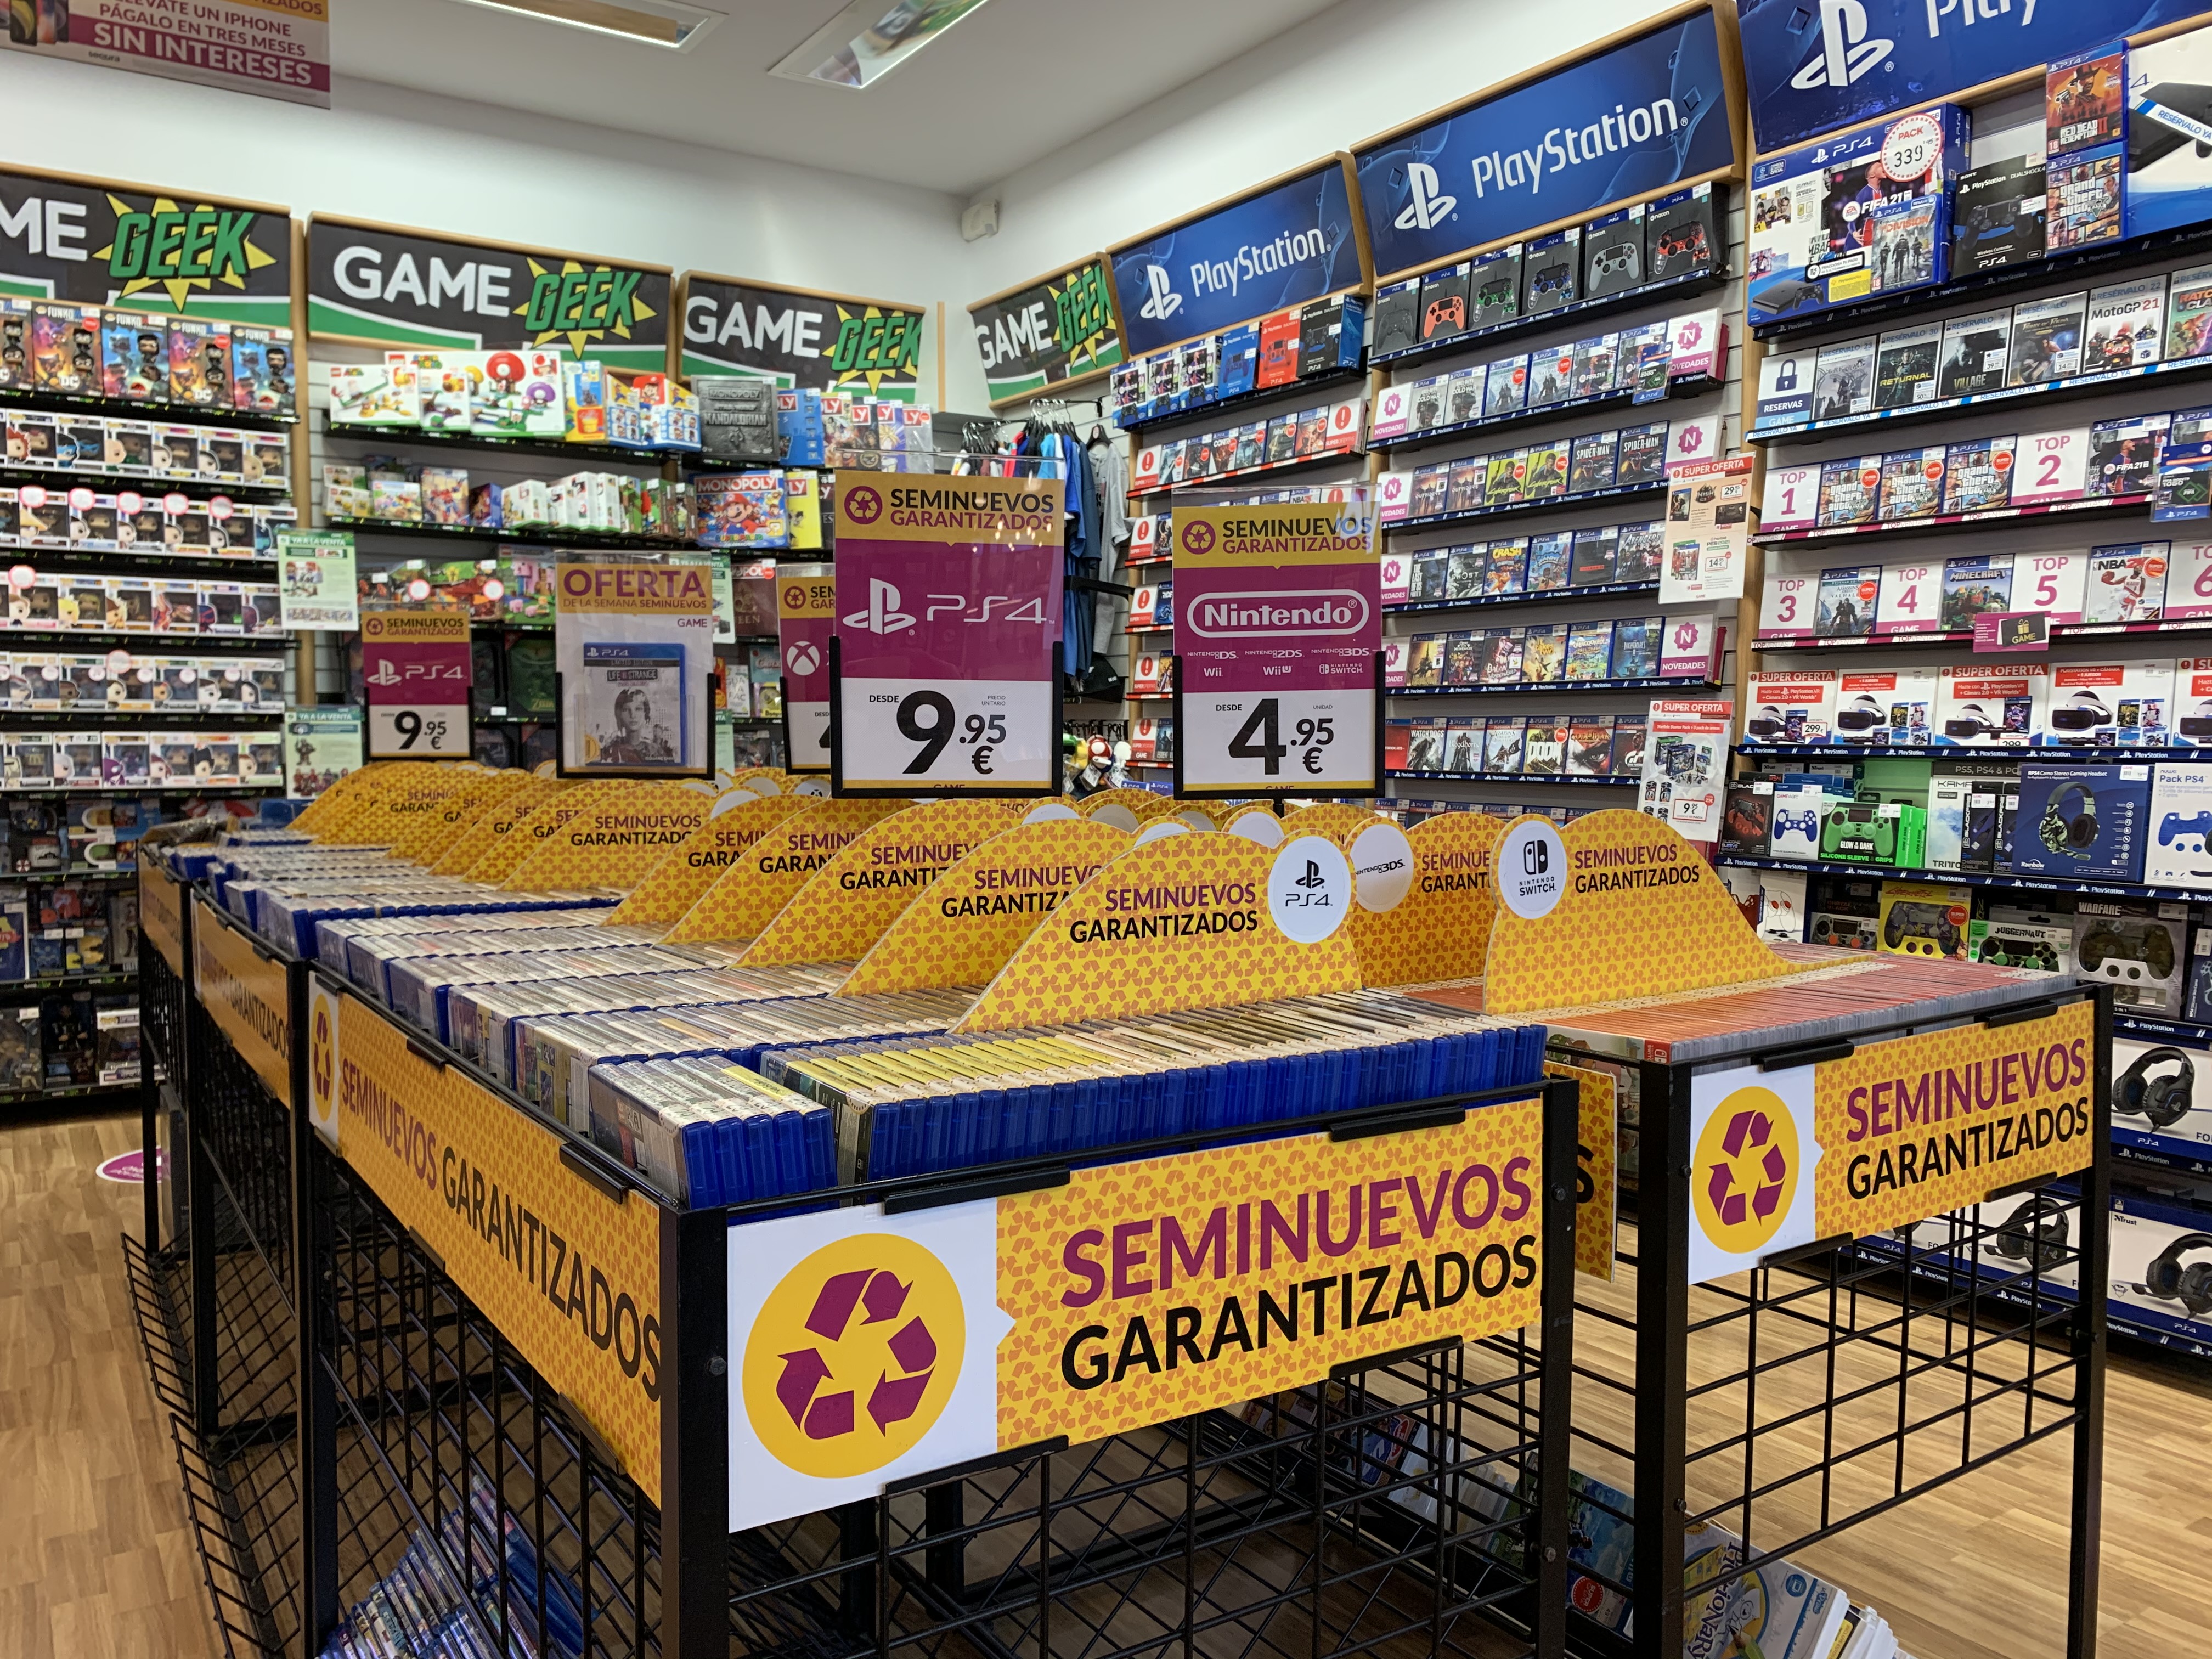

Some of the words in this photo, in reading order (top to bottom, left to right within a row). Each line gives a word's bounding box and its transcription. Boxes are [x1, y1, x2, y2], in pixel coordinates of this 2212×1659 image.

[194, 6, 220, 22] UN
[224, 13, 292, 37] IPHONE
[99, 2, 172, 30] PÁGALO
[177, 20, 201, 33] EN
[205, 24, 247, 44] TRES
[251, 36, 306, 57] MESES
[94, 22, 146, 53] SIN
[155, 33, 312, 85] INTERESES
[2060, 57, 2082, 68] PS4
[2061, 126, 2075, 138] RED
[2077, 120, 2097, 134] DEAD
[2158, 110, 2202, 136] RESÉRVALO
[1898, 127, 1923, 141] PACK
[2061, 129, 2098, 145] REDEMPTION
[1471, 98, 1678, 198] PlayStation
[1833, 136, 1872, 157] PS4
[2049, 142, 2058, 151] 18
[1894, 145, 1923, 167] 339
[2060, 157, 2081, 166] PS4
[1972, 175, 2006, 190] PlayStation
[2059, 177, 2096, 199] grand
[1861, 198, 1888, 214] FIFA
[1889, 192, 1902, 205] 21
[2068, 189, 2103, 204] theft
[1884, 207, 1902, 215] PS4
[2060, 204, 2088, 217] auto
[0, 198, 88, 262] ME
[109, 211, 256, 278] GEEK
[1190, 228, 1327, 298] PlayStation
[1979, 256, 2007, 268] PS4
[333, 245, 511, 317] GAME
[524, 270, 642, 331] GEEK
[2097, 285, 2145, 300] RESÉRVALO
[2021, 300, 2067, 315] RESÉRVALO
[2091, 302, 2140, 320] MotoGP
[2142, 298, 2159, 311] 21
[974, 302, 1053, 370] GAME
[1056, 263, 1114, 353] GEEK
[1951, 316, 1994, 330] RESÉRVALO
[682, 296, 823, 358] GAME
[830, 314, 923, 371] GEEK
[1886, 330, 1926, 343] RESÉRVALO
[1824, 344, 1860, 357] RESÉRVALO
[1880, 372, 1932, 387] RETURNAL
[1954, 374, 1987, 390] VILLAGE
[709, 390, 759, 399] MONOPOLY
[1764, 400, 1803, 413] RESERVAS
[704, 413, 766, 426] MANDALORIAN
[1769, 415, 1795, 427] GAME
[1375, 424, 1404, 436] NOVEDADES
[1624, 437, 1659, 452] SPIDER-MAN
[2035, 436, 2071, 452] TOP
[1577, 445, 1610, 460] SPIDER-MAN
[1684, 464, 1711, 476] SUPER
[1712, 460, 1745, 472] OFERTA
[1958, 464, 1989, 481] grand
[2036, 455, 2061, 487] 2
[2117, 463, 2134, 471] FIFA
[698, 478, 775, 492] MONOPOLY
[1780, 472, 1807, 484] TOP
[1963, 476, 1994, 484] theft
[1831, 481, 1857, 496] grand
[1956, 486, 1981, 496] auto
[890, 489, 1054, 514] SEMINUEVOS
[1781, 488, 1796, 515] 1
[1835, 492, 1863, 501] theft
[890, 510, 1053, 531] GARANTIZADOS
[1222, 517, 1372, 538] SEMINUEVOS
[1222, 535, 1372, 554] GARANTIZADOS
[1492, 548, 1522, 558] CRASH
[2033, 557, 2069, 571] TOP
[2098, 560, 2126, 571] NBA
[1898, 568, 1927, 582] TOP
[1949, 569, 2006, 582] MINECRAFT
[563, 569, 706, 598] OFERTA
[1778, 580, 1805, 591] TOP
[2034, 575, 2058, 606] 5
[563, 599, 575, 607] DE
[578, 599, 589, 607] LA
[591, 599, 637, 607] SEMANA
[640, 599, 707, 608] SEMINUEVOS
[1897, 585, 1918, 614] 4
[927, 595, 1047, 623] PS4
[1204, 602, 1352, 627] Nintendo
[1778, 596, 1797, 623] 3
[387, 618, 464, 629] SEMINUEVOS
[677, 618, 708, 628] GAME
[387, 626, 464, 636] GARANTIZADOS
[2012, 634, 2036, 644] GAME
[602, 648, 629, 657] PS4
[405, 664, 464, 680] PS4
[1204, 667, 1222, 677] Wii
[1662, 662, 1706, 670] NOVEDADES
[1956, 668, 1990, 676] SUPER
[1992, 665, 2044, 675] OFERTA
[628, 670, 658, 680] STRANGE
[1761, 673, 1791, 682] SUPER
[1793, 672, 1833, 681] OFERTA
[1664, 703, 1689, 712] SUPER
[1691, 703, 1723, 713] OFERTA
[1805, 725, 1820, 733] 299
[1528, 742, 1562, 763] DOOM
[972, 746, 994, 775] €
[1302, 747, 1323, 774] €
[2185, 775, 2204, 783] PS4
[595, 815, 701, 829] SEMINUEVOS
[571, 831, 692, 846] GARANTIZAD
[1840, 841, 1853, 850] GLOW
[1859, 842, 1874, 850] DARK
[1421, 850, 1490, 871] SEMINUE
[1575, 844, 1677, 868] SEMINUEVOS
[840, 867, 948, 890] GARANTI
[974, 865, 1103, 890] SEMINUEV
[1421, 872, 1492, 893] GARANTI
[1519, 876, 1554, 887] NINTENDO
[1576, 866, 1700, 894] GARANTIZADOS
[1106, 883, 1256, 911] SEMINUEVOS
[1519, 883, 1556, 896] SWITCH
[2092, 887, 2125, 895] PlayStation
[1285, 893, 1333, 907] PS4
[2078, 902, 2122, 916] WARFARE
[1070, 910, 1257, 943] GARANTIZADOS
[1995, 926, 2046, 939] JUGGERNAUT
[2139, 1022, 2175, 1032] PlayStation
[1846, 1038, 2086, 1143] SEMINUEVOS
[1847, 1097, 2089, 1200] GARANTIZADOS
[2137, 1137, 2160, 1147] PS4
[2134, 1152, 2170, 1165] PlayStation
[342, 1057, 437, 1191] SEMINUEVOS
[442, 1145, 661, 1402] GARANTIZADOS
[1061, 1156, 1531, 1310] SEMINUEVOS
[1061, 1234, 1537, 1390] GARANTIZADOS
[2106, 1322, 2138, 1336] PlayStation
[2174, 1323, 2197, 1334] PS4
